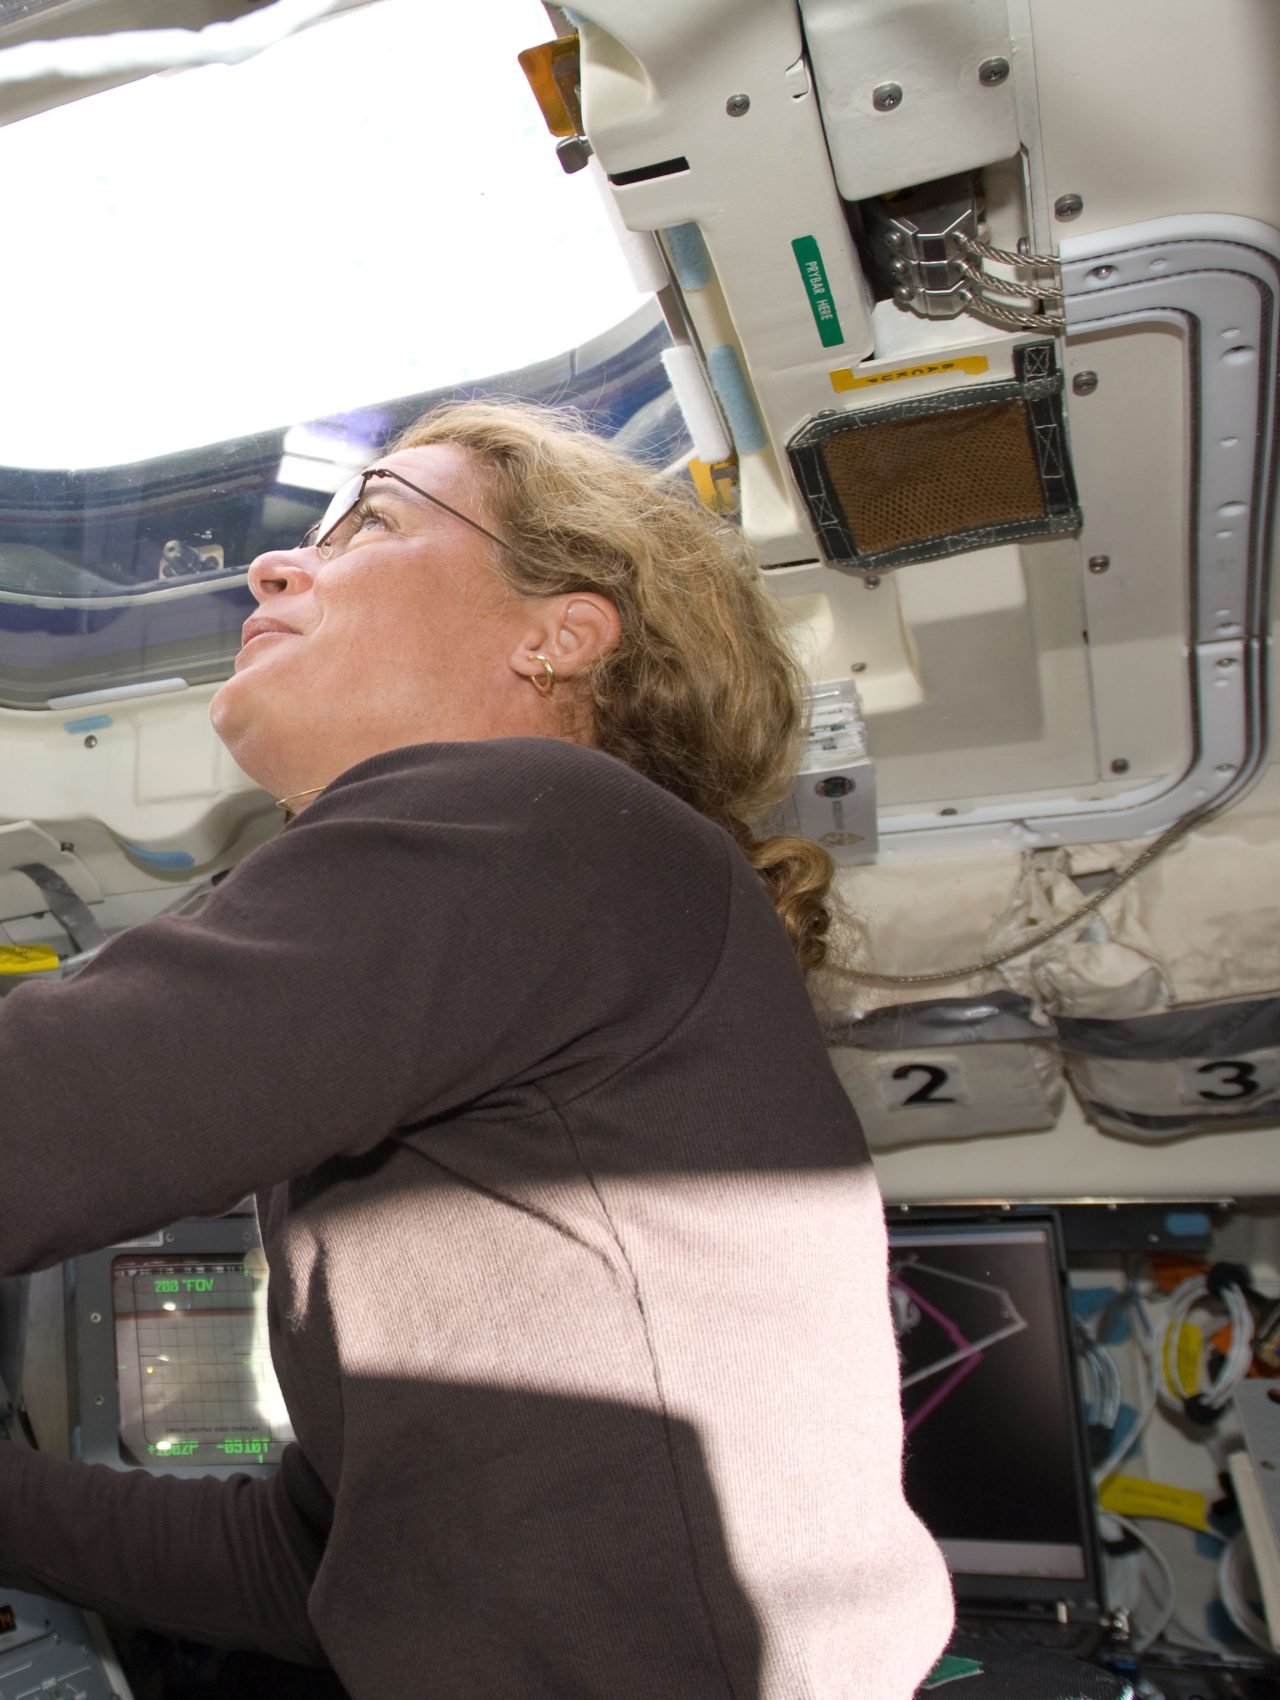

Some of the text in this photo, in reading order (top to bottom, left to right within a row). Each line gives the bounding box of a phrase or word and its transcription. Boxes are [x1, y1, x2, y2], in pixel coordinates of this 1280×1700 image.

[805, 261, 833, 320] PRYBAR HERE
[867, 363, 954, 383] BACKUP
[892, 1064, 957, 1106] 2
[1197, 1061, 1260, 1100] 3
